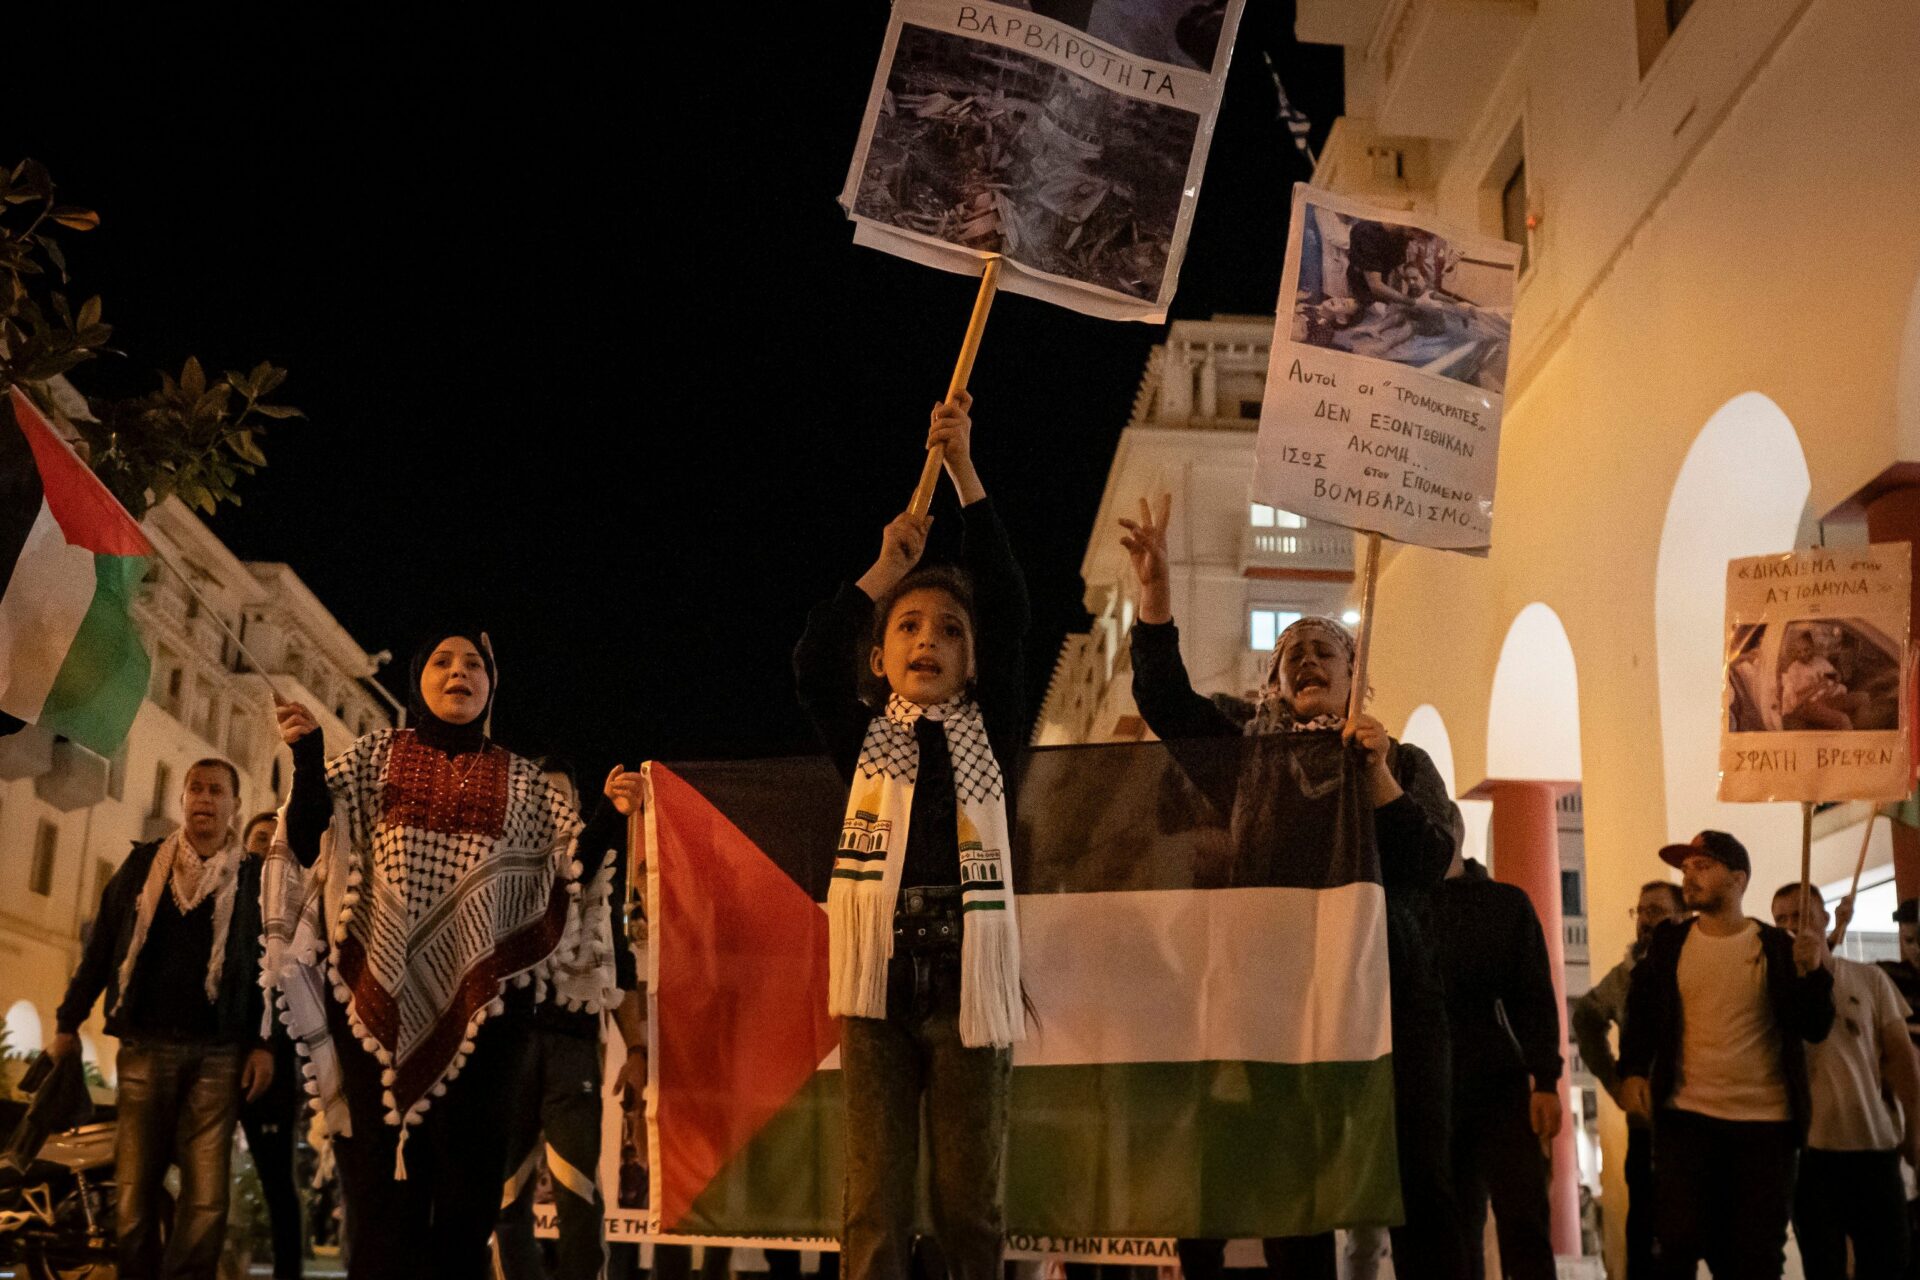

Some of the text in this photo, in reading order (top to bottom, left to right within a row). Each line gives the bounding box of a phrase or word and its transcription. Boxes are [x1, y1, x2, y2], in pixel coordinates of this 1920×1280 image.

[957, 6, 1175, 99] ΒΑΡΒΑΡΟΤΗΤΑ
[1314, 400, 1475, 458] ΔΕΝ ΕΞΟΝΤΩΘΗΚΑΝ
[1282, 445, 1327, 470] ΙΣΩΣ
[1734, 749, 1797, 773] ΣΦΑΓΗ
[1049, 1236, 1103, 1255] ΣΤΗΝ
